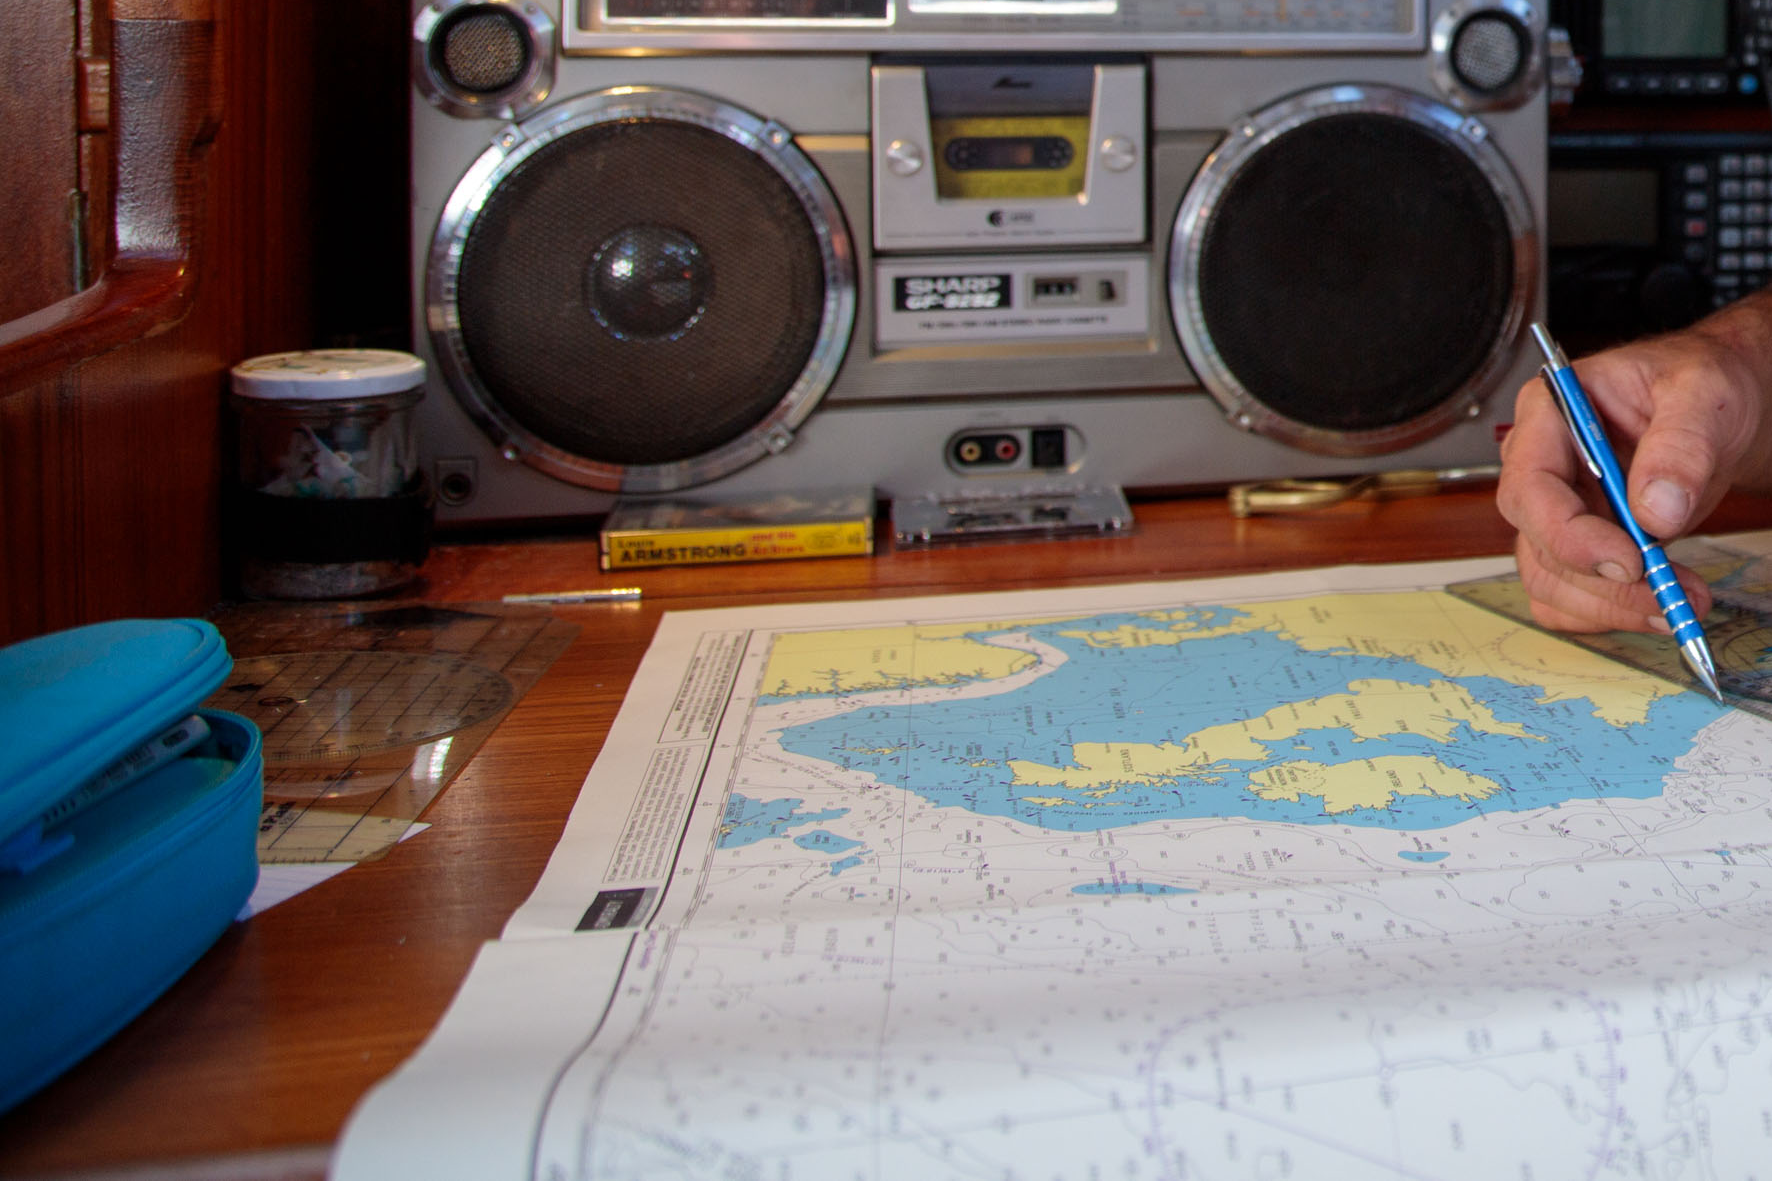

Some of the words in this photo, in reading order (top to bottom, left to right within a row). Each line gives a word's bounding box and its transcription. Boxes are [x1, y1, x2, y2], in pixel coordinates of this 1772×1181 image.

[904, 276, 1000, 295] SHARP
[621, 543, 747, 563] ARMSTRONG
[1110, 702, 1125, 719] NORTH
[1345, 700, 1363, 719] ENGLAND
[1120, 749, 1134, 772] SCOTLAND
[1386, 770, 1402, 788] IRELAND
